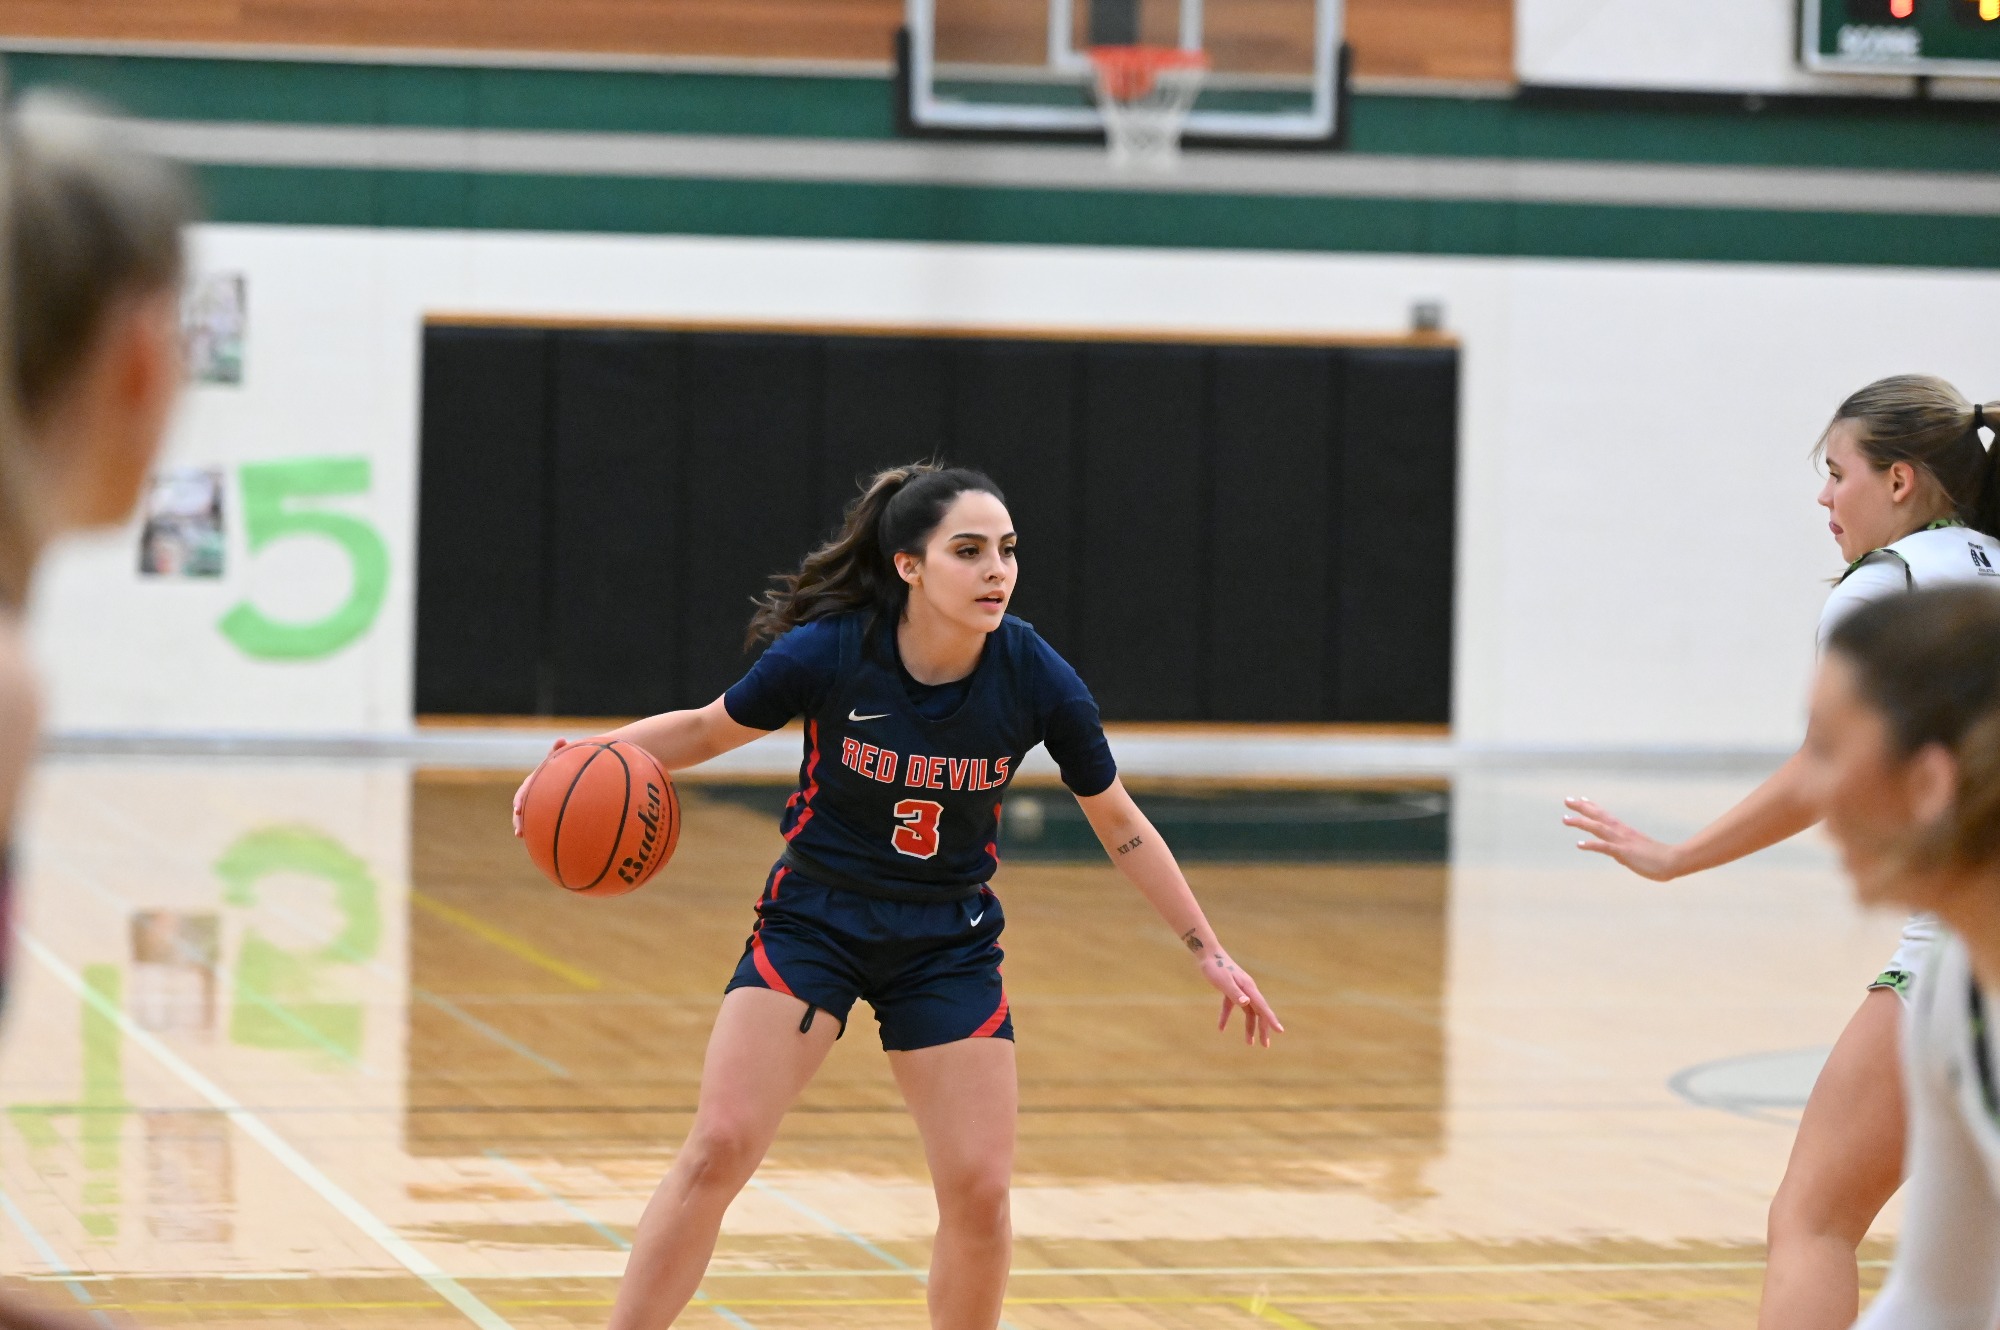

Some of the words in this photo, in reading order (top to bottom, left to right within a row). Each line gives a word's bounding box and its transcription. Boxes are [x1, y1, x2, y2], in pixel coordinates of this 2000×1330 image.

[218, 454, 390, 661] 5
[842, 736, 899, 784] RED
[904, 754, 1012, 792] DEVILS
[617, 782, 661, 885] Baden
[890, 798, 945, 861] 3
